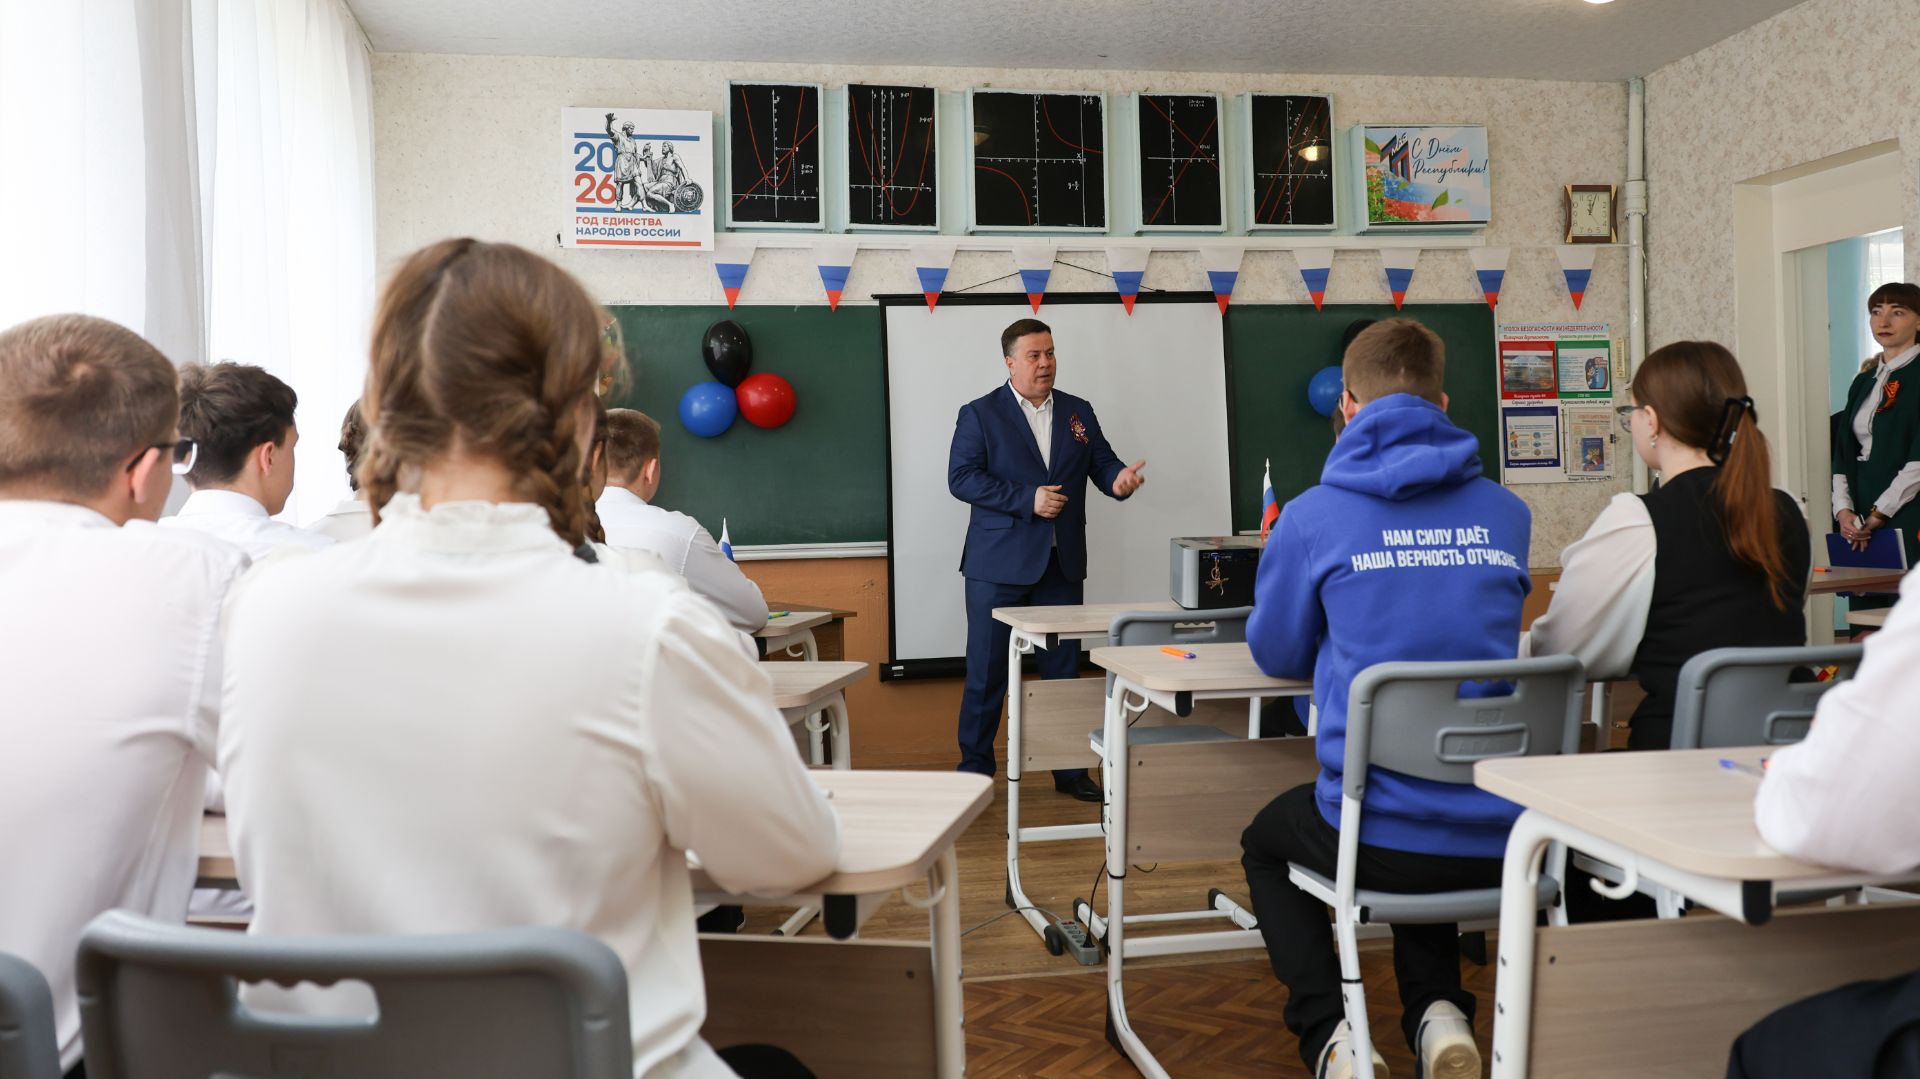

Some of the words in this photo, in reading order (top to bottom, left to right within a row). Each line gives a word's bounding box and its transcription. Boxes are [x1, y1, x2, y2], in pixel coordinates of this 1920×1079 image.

[574, 141, 617, 173] 20
[1411, 138, 1423, 160] С
[1427, 137, 1463, 160] Днём
[1413, 159, 1489, 184] Республики!
[574, 172, 617, 205] 26
[575, 216, 599, 226] ГОД
[602, 217, 663, 227] ЕДИНСТВА
[575, 227, 631, 237] НАРОДОВ
[634, 228, 681, 237] РОССИИ
[1382, 529, 1415, 547] НАМ
[1415, 528, 1452, 546] СИЛУ
[1456, 525, 1490, 546] ДАЁТ
[1351, 552, 1395, 572] НАША
[1396, 549, 1465, 568] ВЕРНОСТЬ
